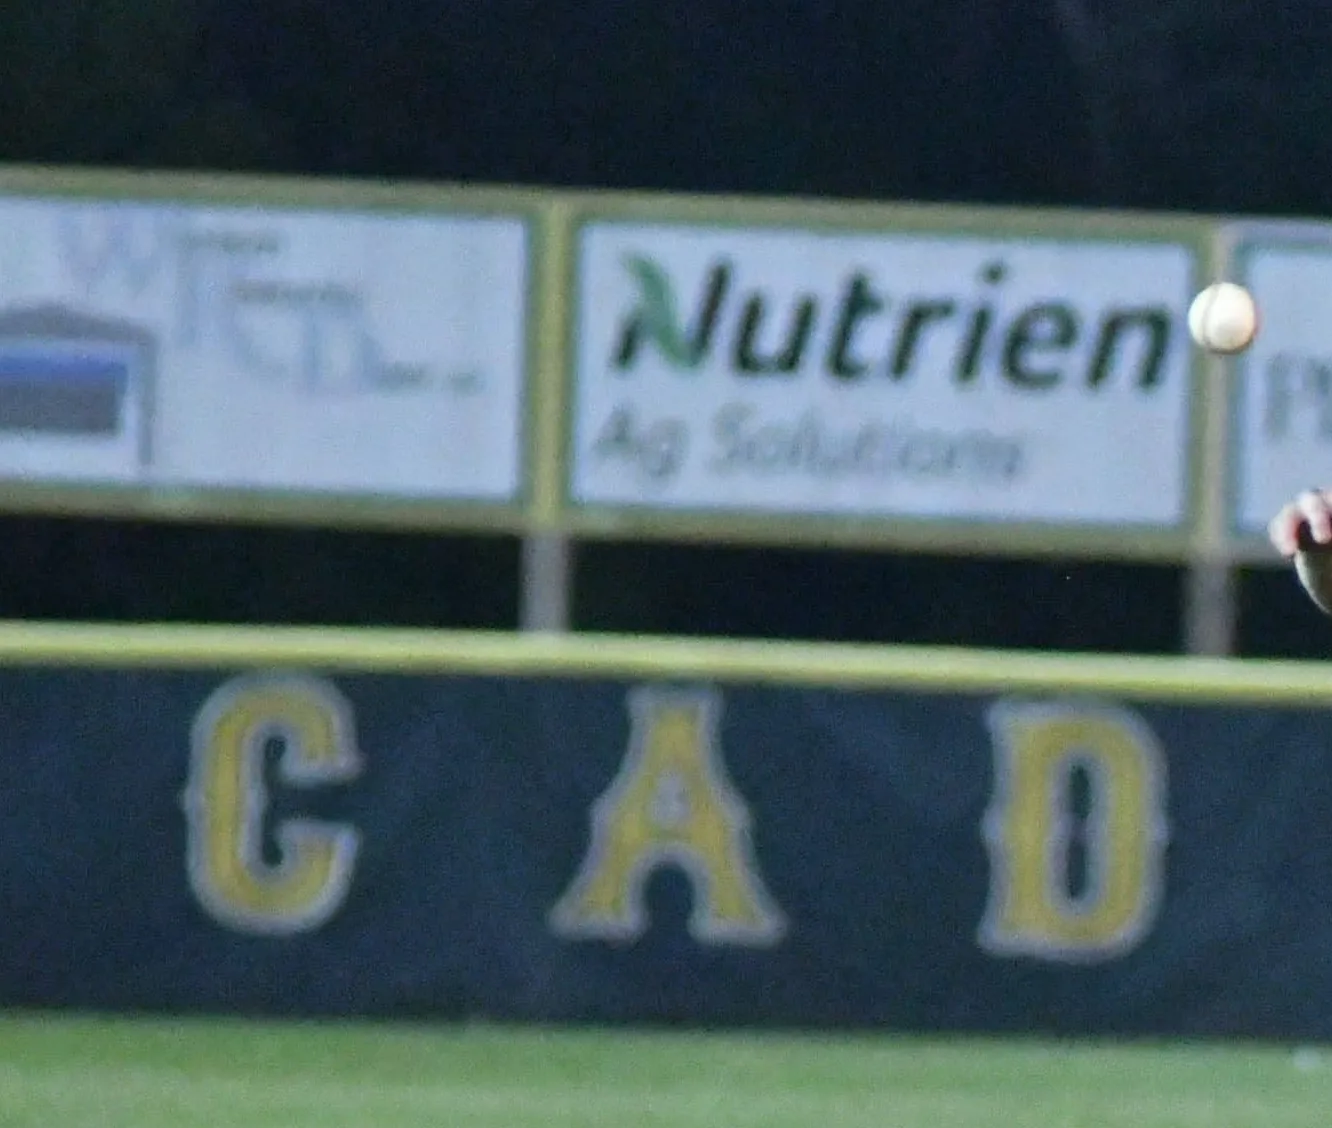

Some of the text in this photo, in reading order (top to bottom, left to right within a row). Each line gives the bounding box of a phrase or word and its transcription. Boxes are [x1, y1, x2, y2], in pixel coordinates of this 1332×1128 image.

[612, 250, 1172, 390] Nutrien
[596, 405, 1024, 494] Ag Solutions
